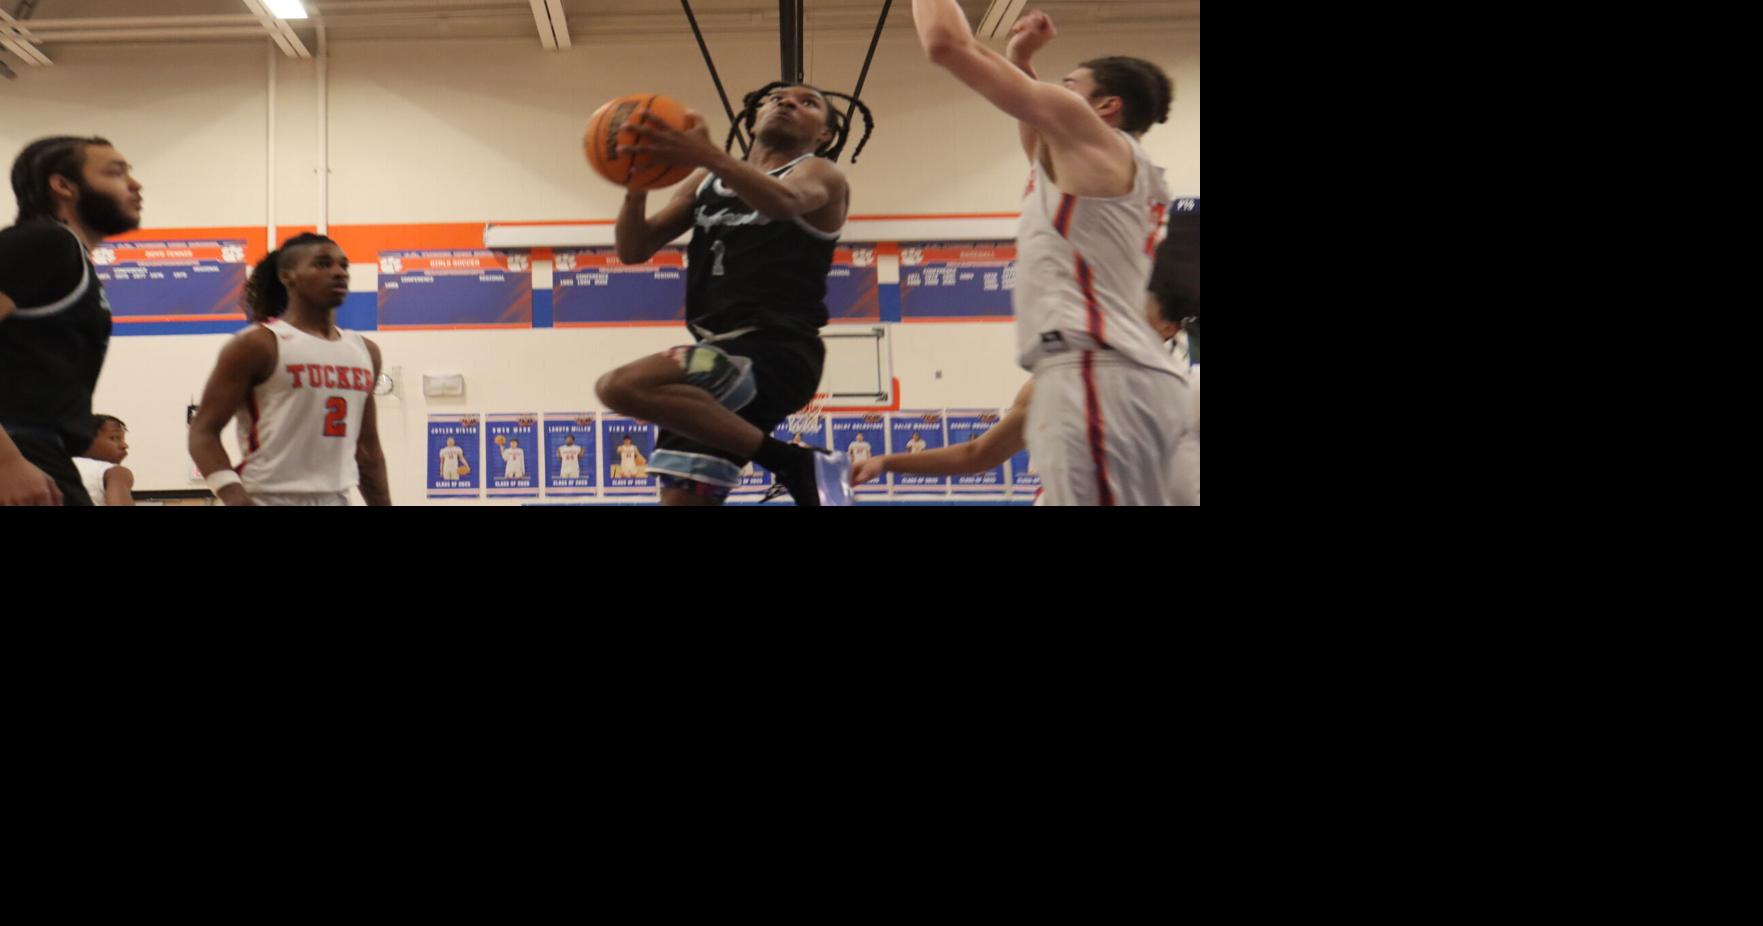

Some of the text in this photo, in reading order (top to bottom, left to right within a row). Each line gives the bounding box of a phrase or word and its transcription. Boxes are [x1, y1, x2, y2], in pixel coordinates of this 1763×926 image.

[430, 258, 480, 267] GIRLS SOCCER
[323, 396, 347, 437] 2
